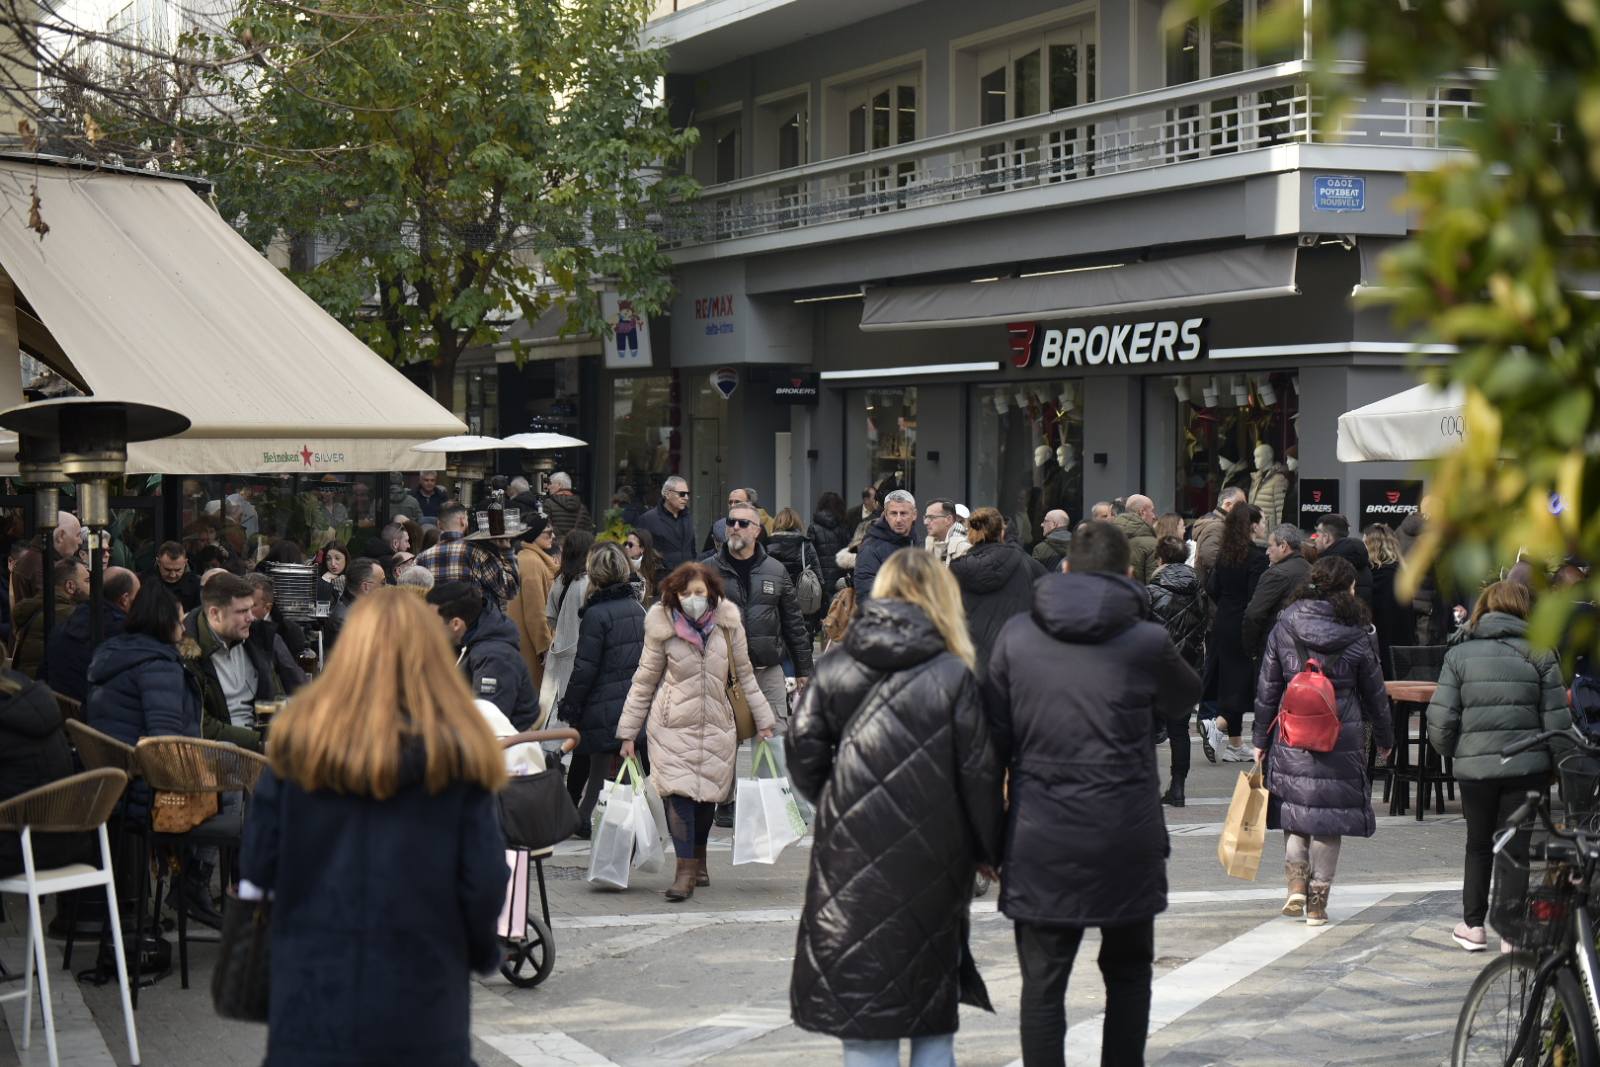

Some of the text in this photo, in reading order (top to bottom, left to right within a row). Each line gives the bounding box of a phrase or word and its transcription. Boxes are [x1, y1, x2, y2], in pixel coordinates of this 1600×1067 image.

[1327, 179, 1353, 188] ΟΔΟΣ
[696, 295, 734, 319] RE/MAX
[1041, 317, 1204, 368] BROKERS
[263, 452, 344, 463] Heineken SILVER
[1302, 504, 1332, 513] BROKERS
[1366, 505, 1418, 513] BROKERS
